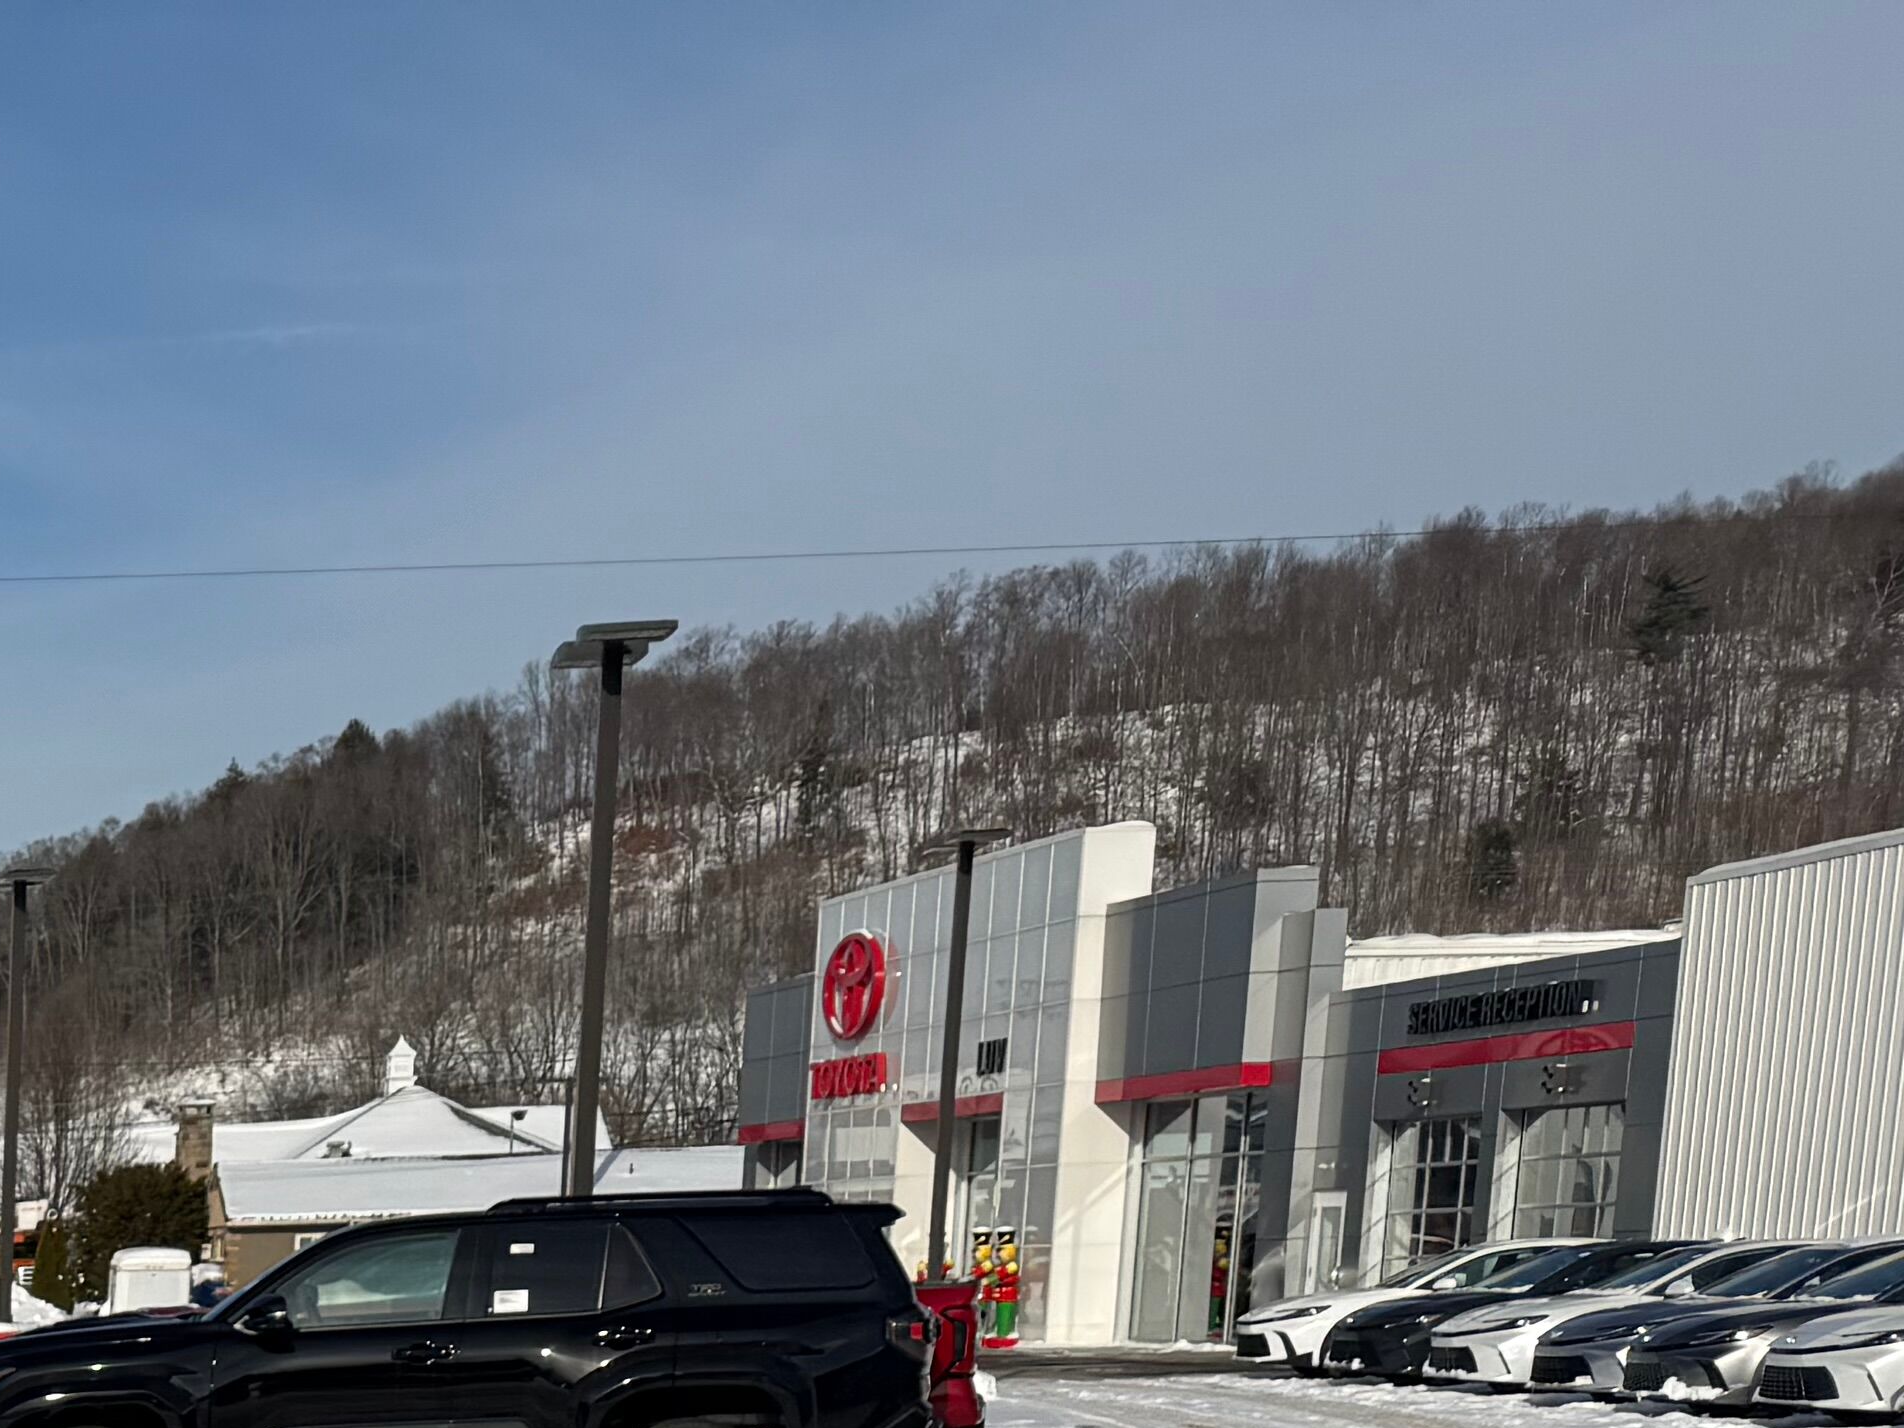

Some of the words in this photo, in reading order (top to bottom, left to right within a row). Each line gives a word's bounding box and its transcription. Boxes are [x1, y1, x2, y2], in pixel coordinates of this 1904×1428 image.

[1407, 996, 1479, 1035] SERVICE
[1480, 981, 1590, 1028] RECEPTION
[809, 1052, 887, 1100] TOYOTA
[977, 1037, 1008, 1076] LUV
